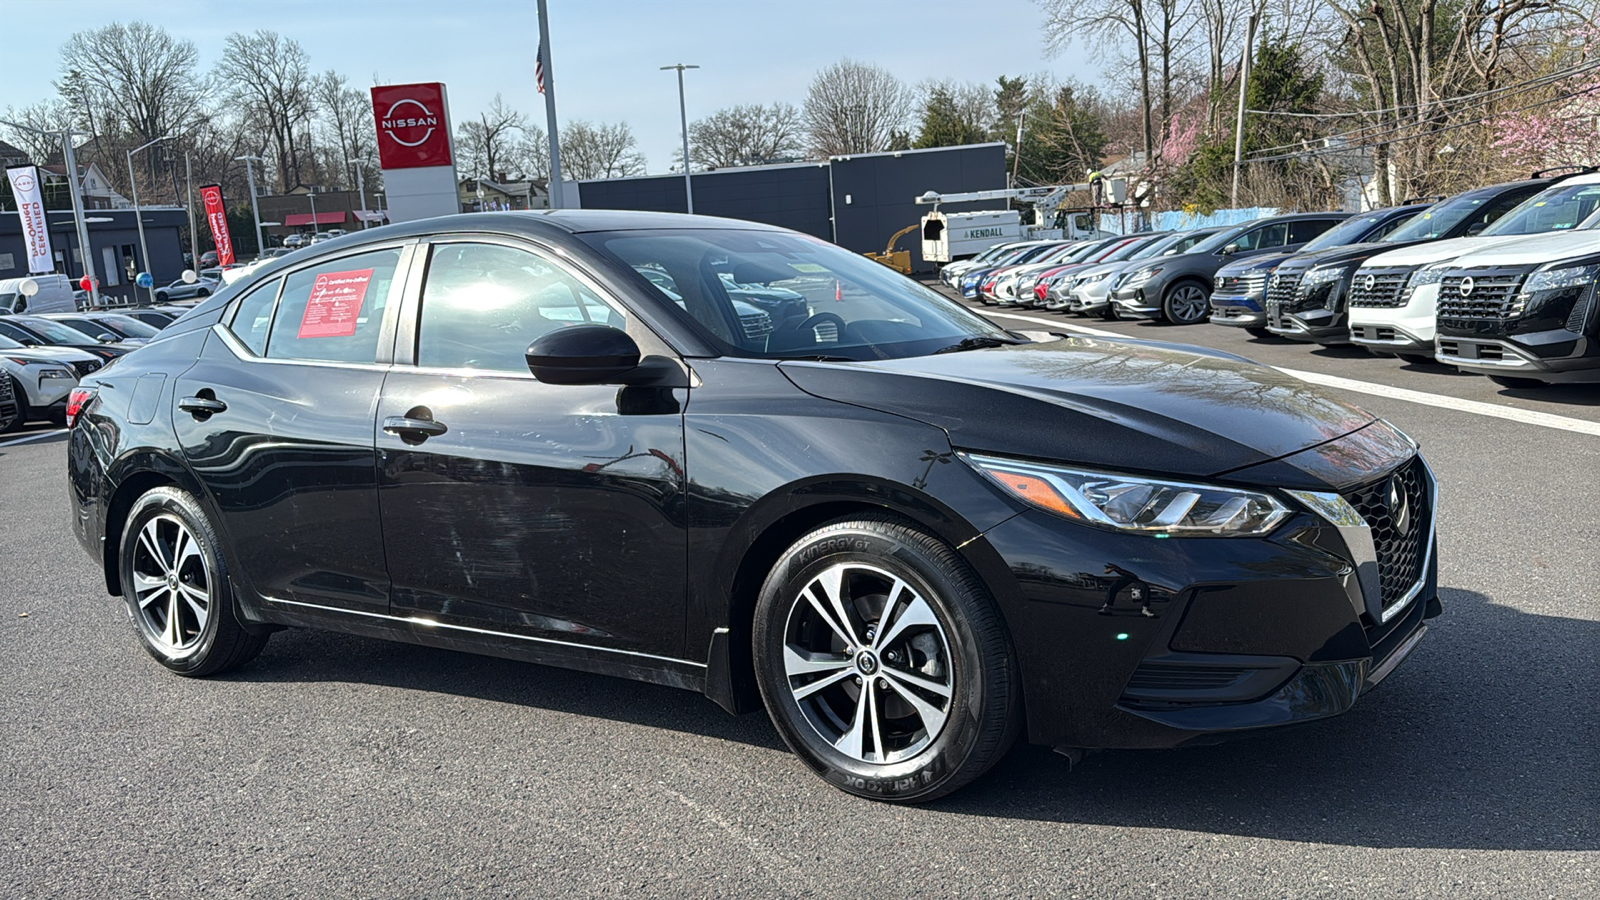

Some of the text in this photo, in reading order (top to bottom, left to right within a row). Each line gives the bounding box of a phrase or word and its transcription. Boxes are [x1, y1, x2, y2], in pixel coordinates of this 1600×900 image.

[382, 117, 437, 129] NISSAN
[970, 227, 1003, 239] KENDALL
[855, 539, 871, 550] GT
